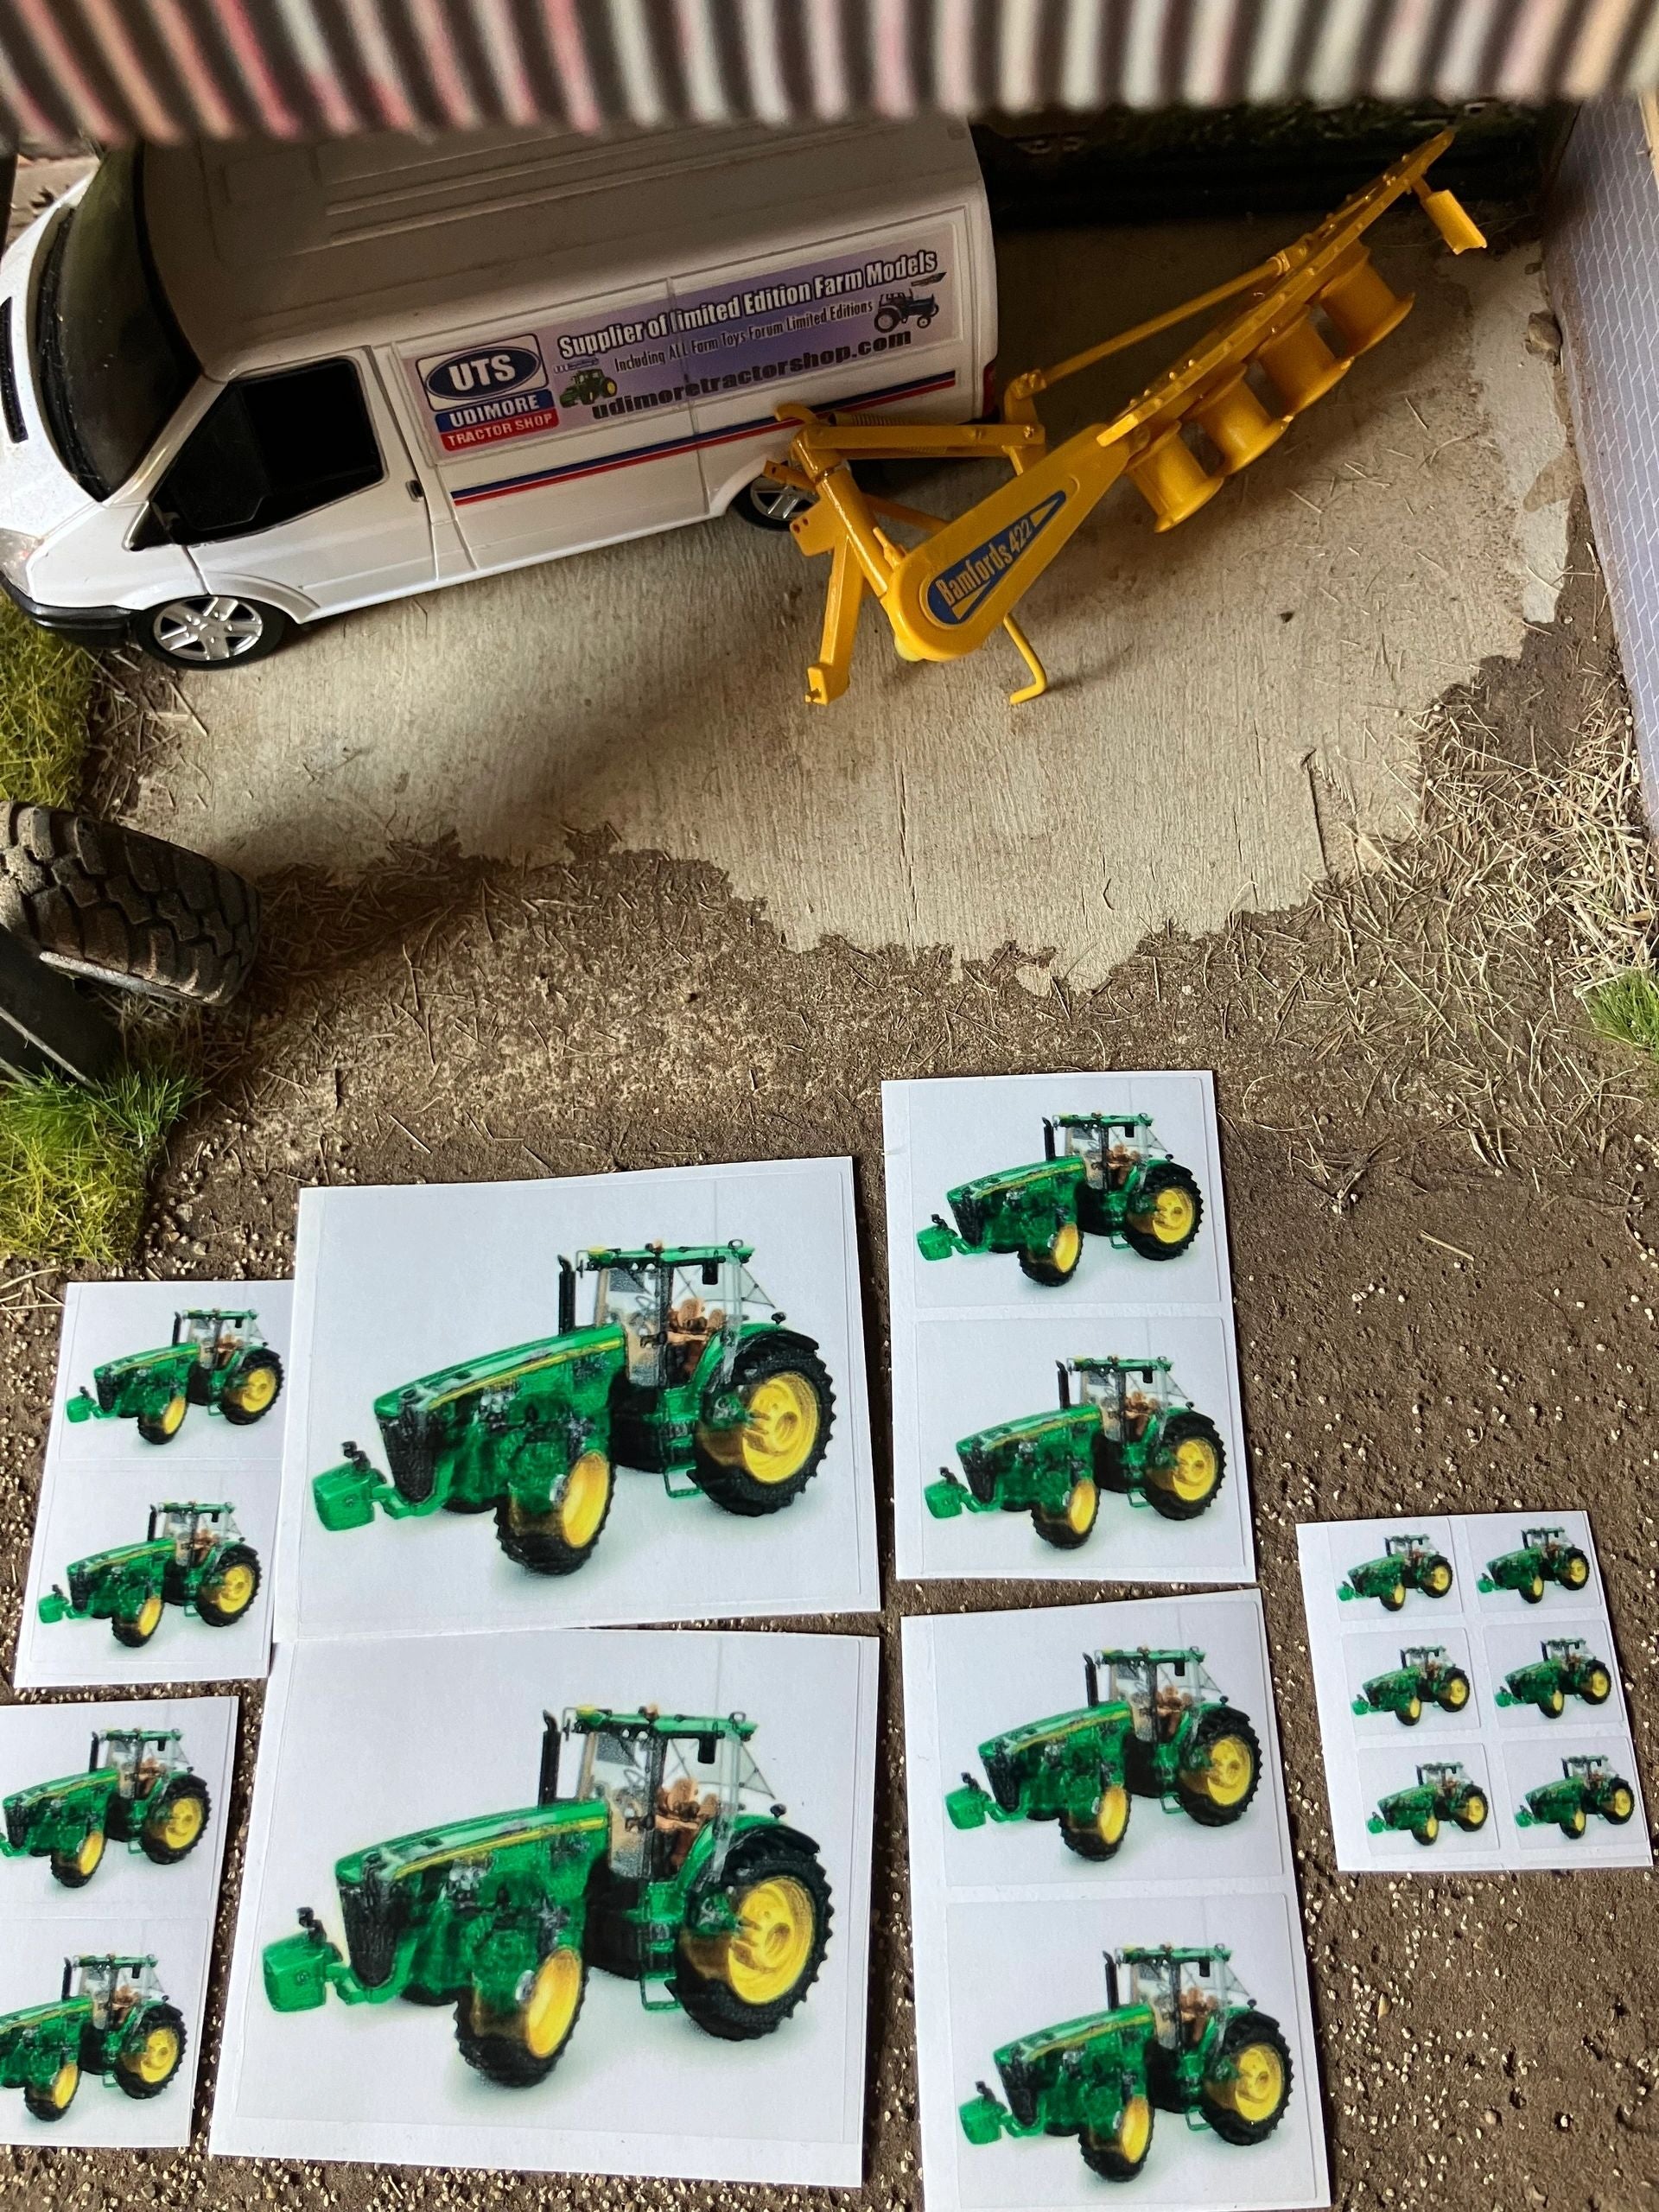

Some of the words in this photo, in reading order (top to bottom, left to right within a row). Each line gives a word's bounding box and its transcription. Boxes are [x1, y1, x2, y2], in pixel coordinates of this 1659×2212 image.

[558, 321, 644, 359] Supplier
[648, 314, 667, 338] of
[743, 281, 811, 316] Edition
[814, 269, 862, 300] Farm
[865, 250, 938, 288] Models
[614, 352, 665, 372] Including
[669, 341, 690, 360] ALL
[692, 338, 718, 355] Farm
[721, 330, 747, 349] Toys
[749, 323, 783, 340] Forum
[786, 308, 827, 332] Limited
[830, 301, 873, 321] Editions
[448, 354, 516, 391] UTS
[592, 331, 912, 419] udimoretractorshop.com
[448, 423, 512, 447] TRACTOR
[515, 413, 553, 431] SHOP
[450, 395, 540, 428] UDIMORE
[935, 543, 1014, 605] Bamfords
[1009, 519, 1033, 553] 422
